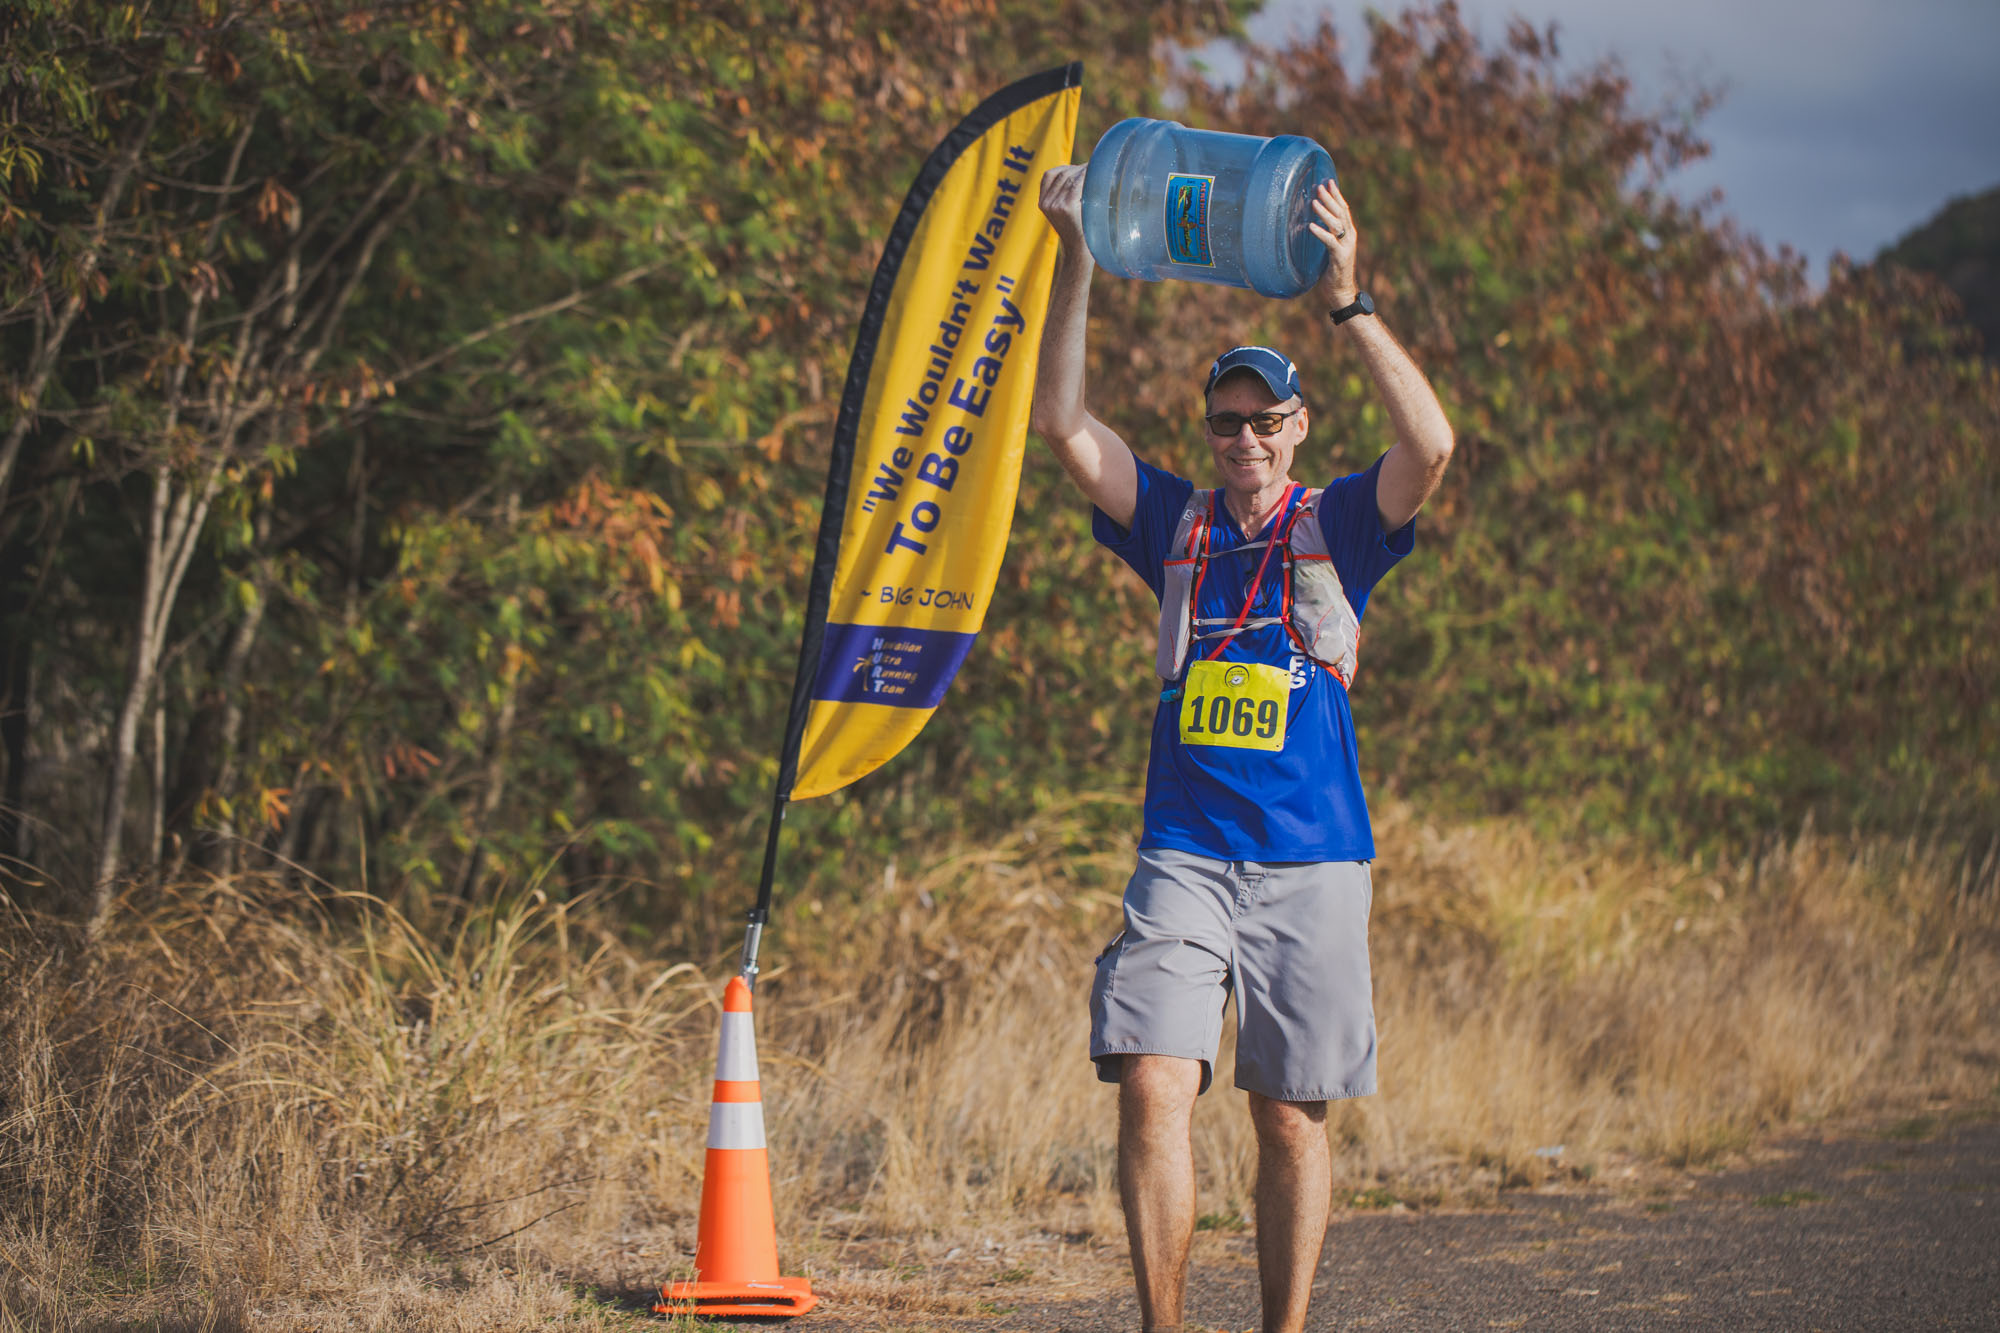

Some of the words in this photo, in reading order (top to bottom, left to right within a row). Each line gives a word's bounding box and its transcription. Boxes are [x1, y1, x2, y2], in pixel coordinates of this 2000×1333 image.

[862, 450, 915, 514] "We
[896, 282, 981, 438] Wouldn't
[963, 175, 1021, 273] Want
[1009, 144, 1037, 174] It
[884, 501, 942, 556] To
[917, 425, 974, 493] Be
[947, 275, 1027, 418] Easy"
[880, 586, 913, 606] BIG
[919, 588, 975, 610] JOHN
[872, 665, 918, 684] Running
[873, 680, 906, 694] Team
[1187, 695, 1279, 739] 1069
